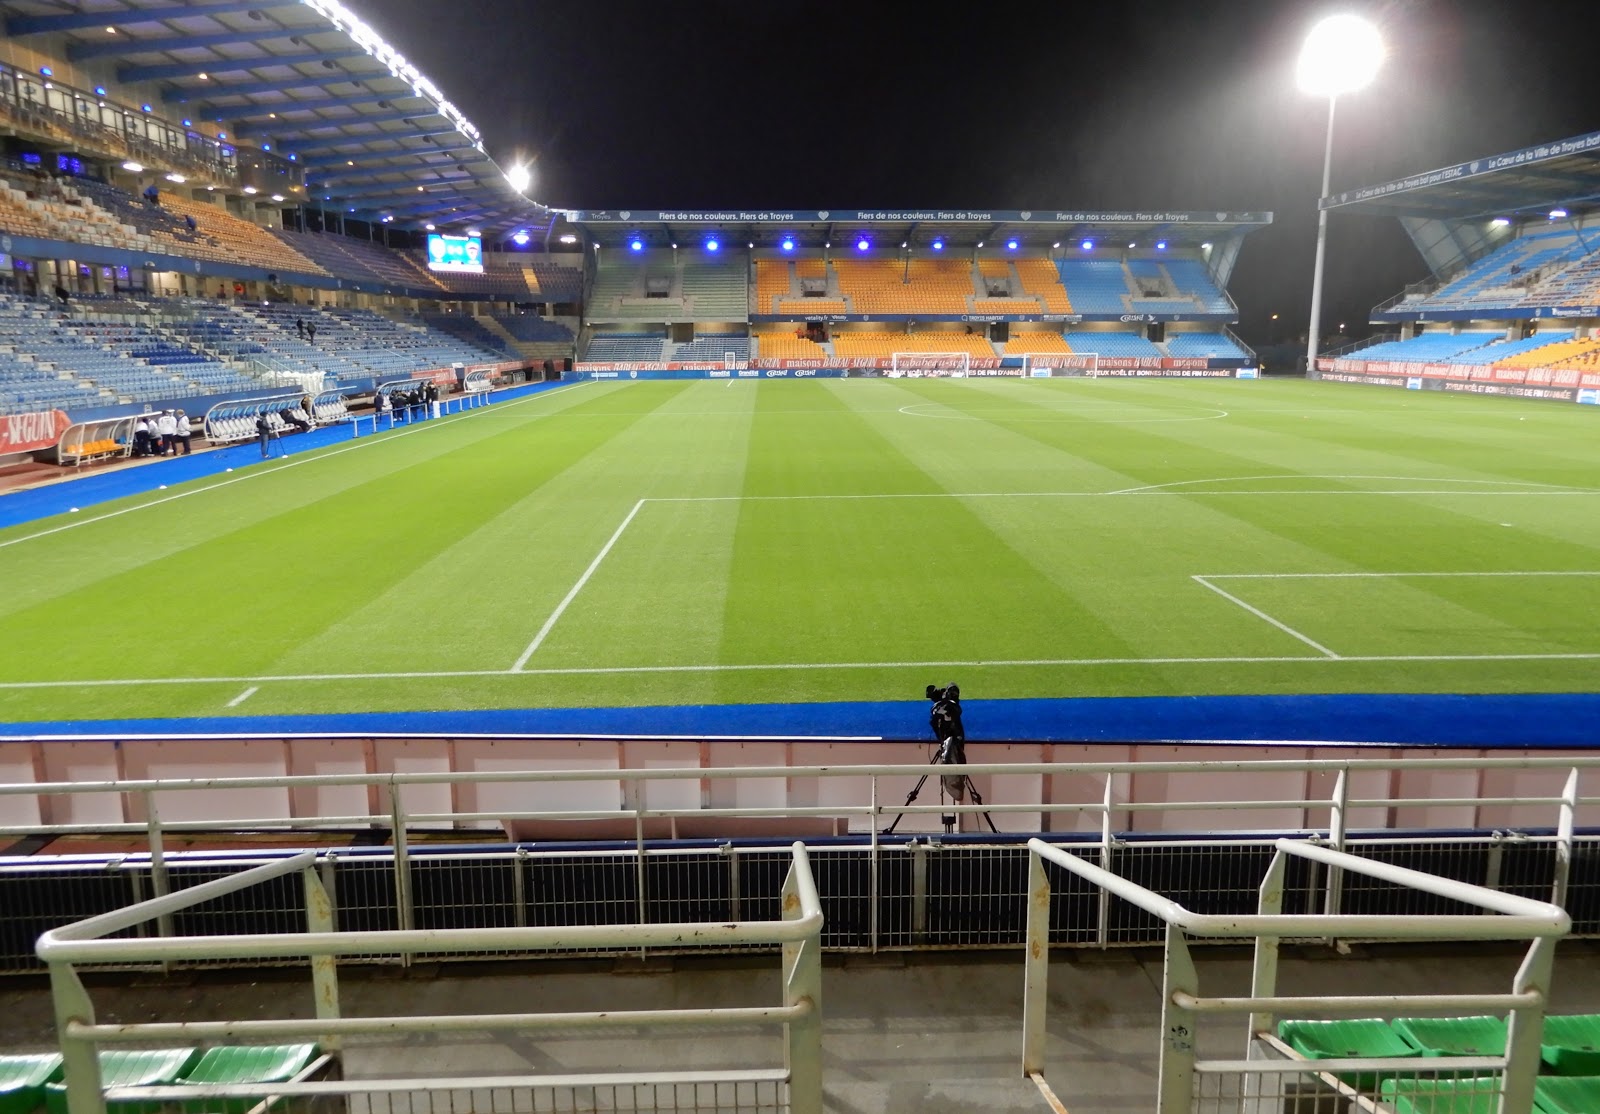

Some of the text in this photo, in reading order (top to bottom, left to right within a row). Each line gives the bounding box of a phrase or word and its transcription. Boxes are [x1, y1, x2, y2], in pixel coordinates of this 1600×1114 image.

[1489, 160, 1496, 168] Le
[1516, 154, 1524, 162] de
[1526, 152, 1533, 160] la
[1534, 148, 1548, 158] Ville
[1550, 145, 1560, 154] de
[1561, 140, 1585, 152] Troyes
[1404, 179, 1419, 189] Troyes
[770, 212, 794, 221] Troyes
[968, 212, 991, 220] Troyes
[1166, 213, 1188, 222] Troyes
[576, 362, 611, 372] maisons
[786, 357, 820, 368] maisons
[1098, 357, 1132, 367] maisons
